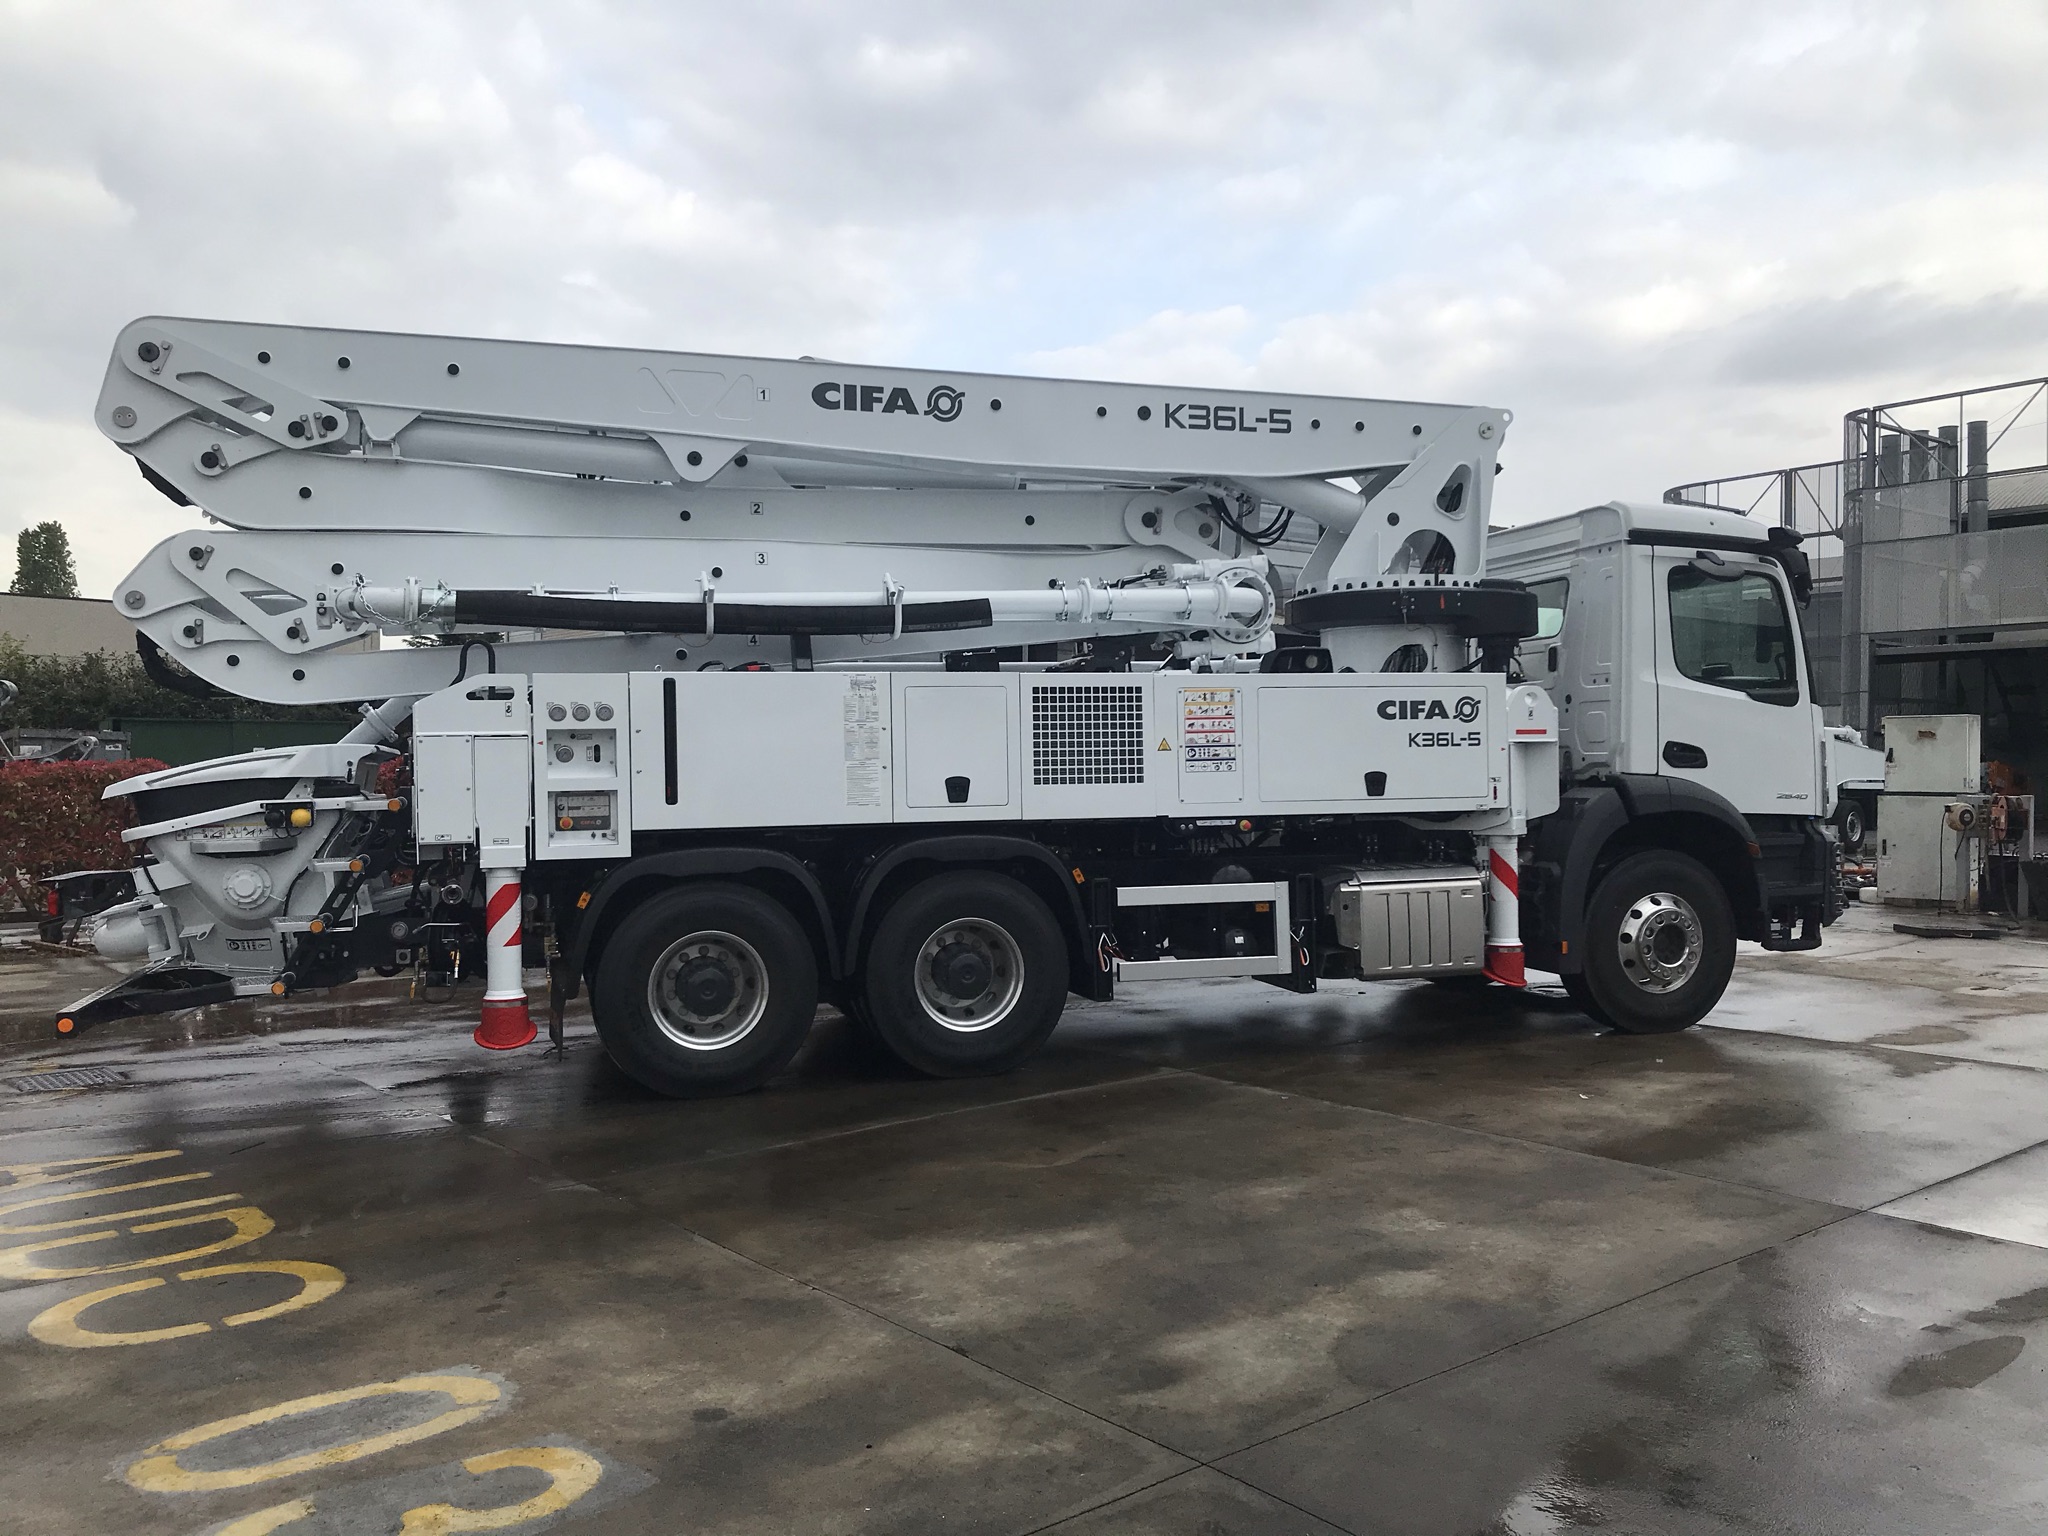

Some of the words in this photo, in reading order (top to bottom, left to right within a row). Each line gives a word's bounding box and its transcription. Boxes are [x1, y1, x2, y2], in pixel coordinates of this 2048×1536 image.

[760, 389, 766, 400] 1
[811, 382, 920, 415] CIFA
[1164, 402, 1292, 434] K36L-5
[753, 503, 761, 514] 2
[757, 553, 765, 564] 3
[749, 634, 758, 645] 4
[1376, 699, 1450, 721] CIFA
[1408, 731, 1481, 747] K36L-5
